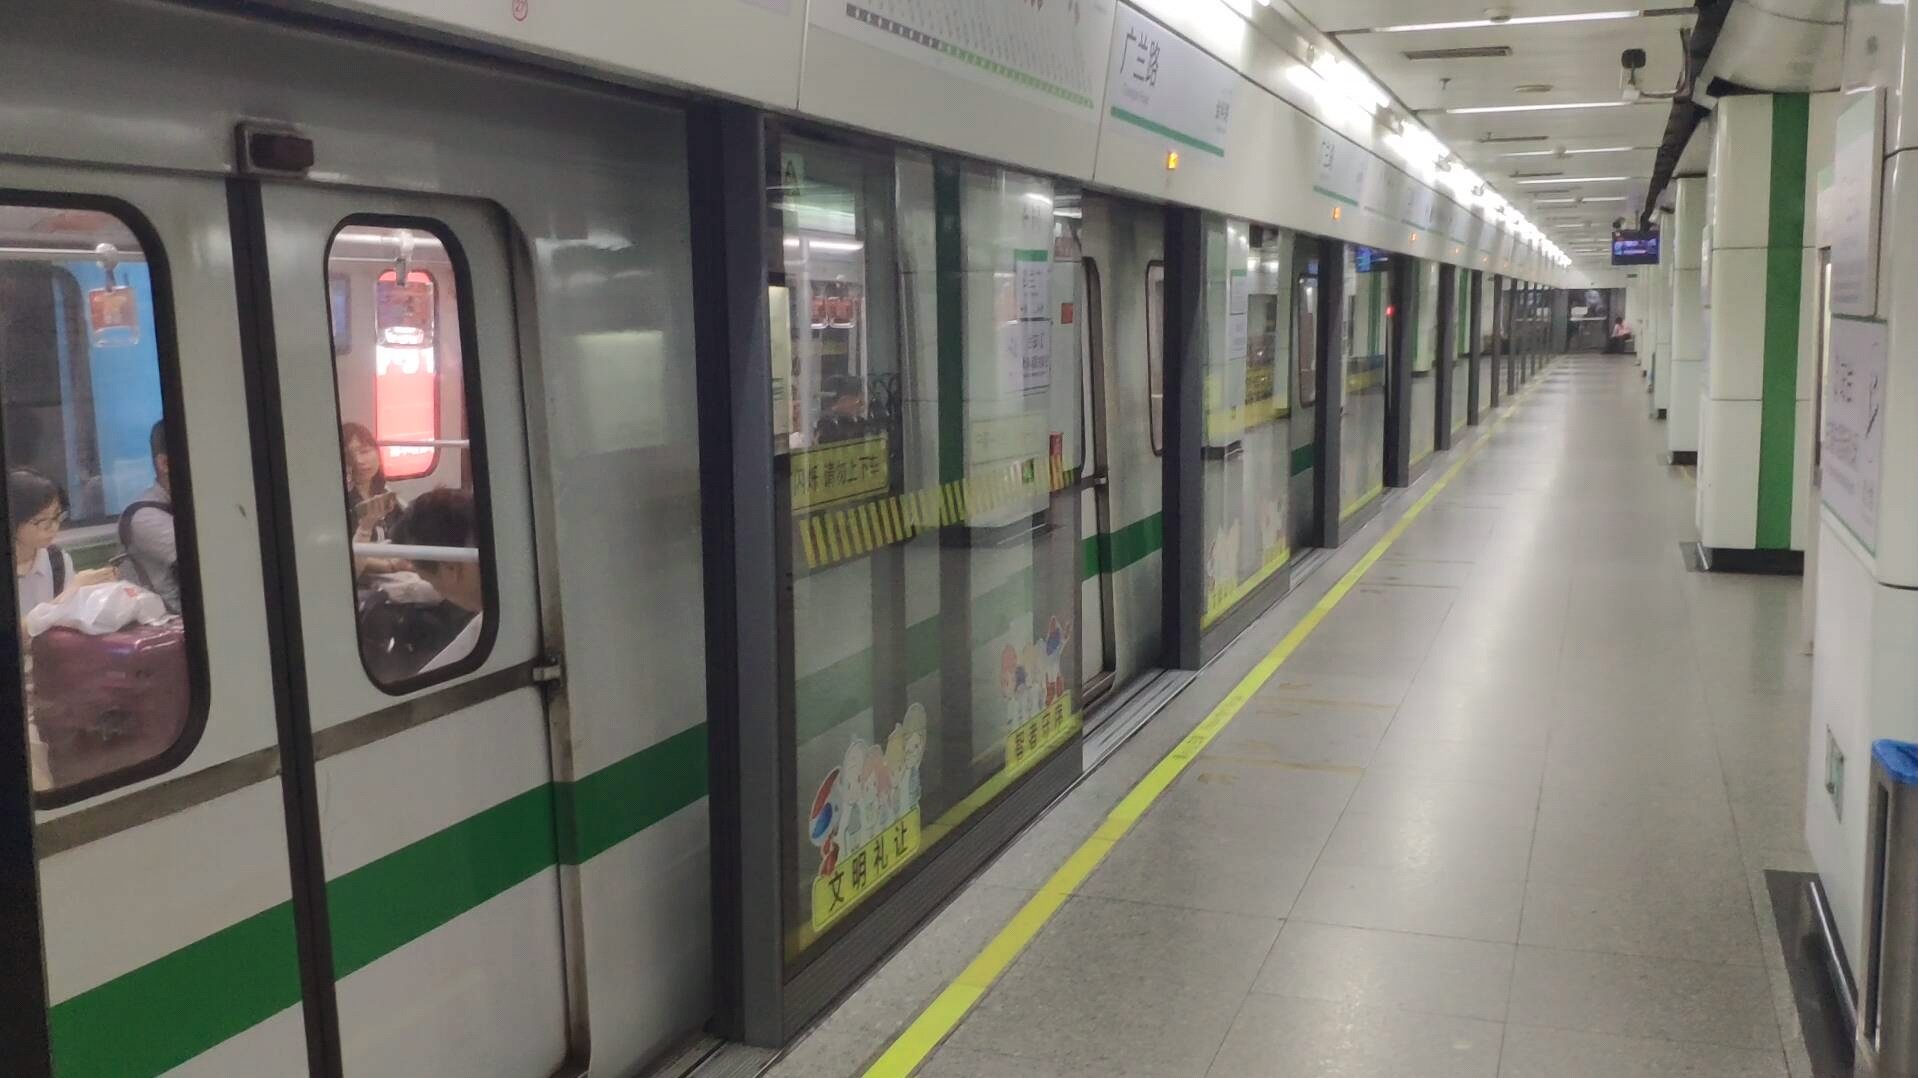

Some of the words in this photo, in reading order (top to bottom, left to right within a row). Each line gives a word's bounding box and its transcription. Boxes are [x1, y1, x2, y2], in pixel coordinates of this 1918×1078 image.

[1119, 24, 1160, 87] 广兰路
[827, 820, 910, 912] 文明礼让
